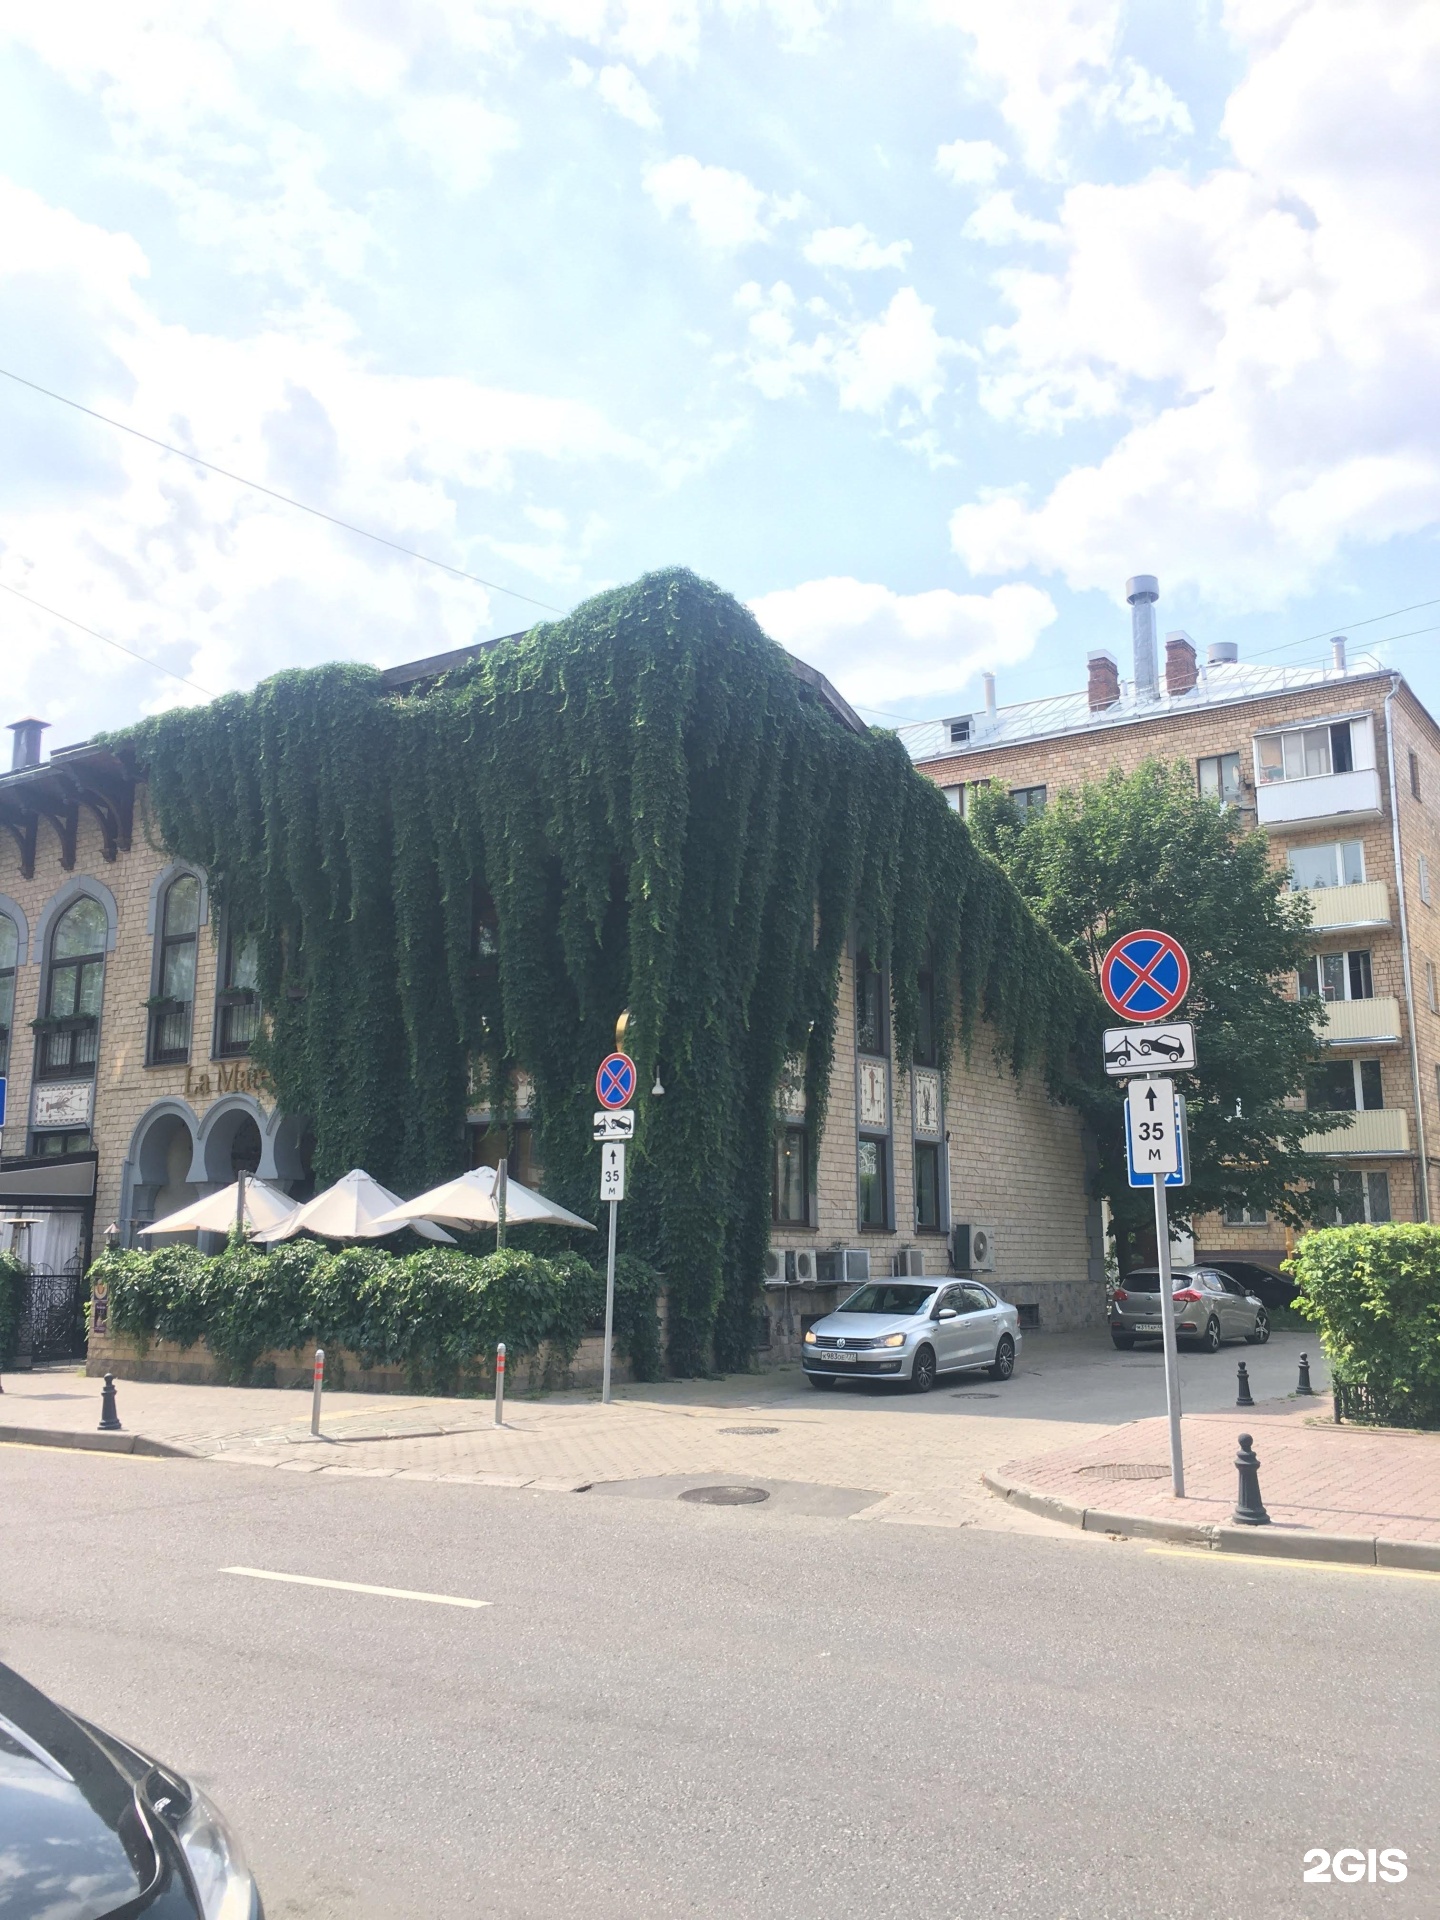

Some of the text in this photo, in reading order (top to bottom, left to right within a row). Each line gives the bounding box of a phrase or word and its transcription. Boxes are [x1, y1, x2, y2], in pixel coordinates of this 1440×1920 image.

[185, 1067, 210, 1097] La
[1138, 1122, 1164, 1141] 35
[605, 1170, 620, 1182] 35
